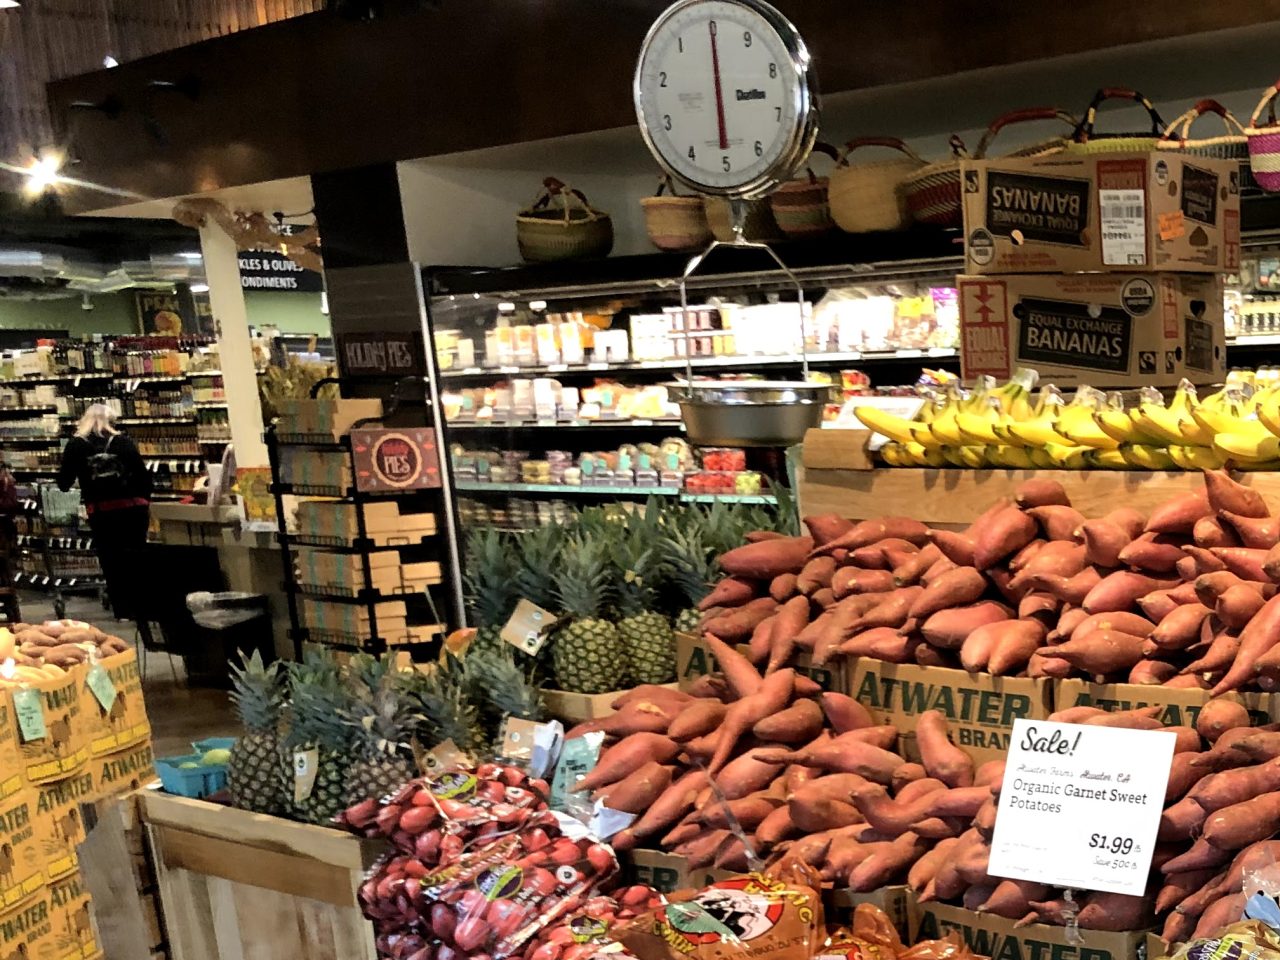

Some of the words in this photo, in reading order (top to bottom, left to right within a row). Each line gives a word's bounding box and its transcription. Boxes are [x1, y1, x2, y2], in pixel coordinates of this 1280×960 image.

[710, 20, 717, 37] 0
[678, 37, 683, 53] 1
[744, 31, 752, 48] 9
[659, 72, 667, 87] 2
[769, 63, 777, 79] 8
[664, 114, 672, 131] 3
[774, 107, 782, 122] 7
[688, 146, 695, 161] 4
[754, 141, 762, 157] 6
[723, 156, 731, 172] 5
[993, 186, 1080, 216] BANANAS
[1049, 216, 1079, 231] EQUAL
[263, 259, 270, 270] &
[242, 276, 297, 289] ONDIMENTS
[1029, 312, 1062, 329] EQUAL
[1066, 317, 1123, 335] EXCHANGE
[1027, 327, 1123, 358] BANANAS
[384, 455, 411, 474] PIES
[855, 669, 1030, 727] ATWATER
[958, 727, 1012, 750] BRAN
[1020, 726, 1082, 757] Sale!
[101, 746, 154, 785] ATWATER
[37, 772, 94, 815] ATWATER
[1013, 778, 1061, 796] Organic
[1064, 784, 1107, 801] Garnet
[1109, 788, 1147, 805] Sweet
[1009, 795, 1062, 814] Potatoes
[1089, 833, 1134, 856] $1.99
